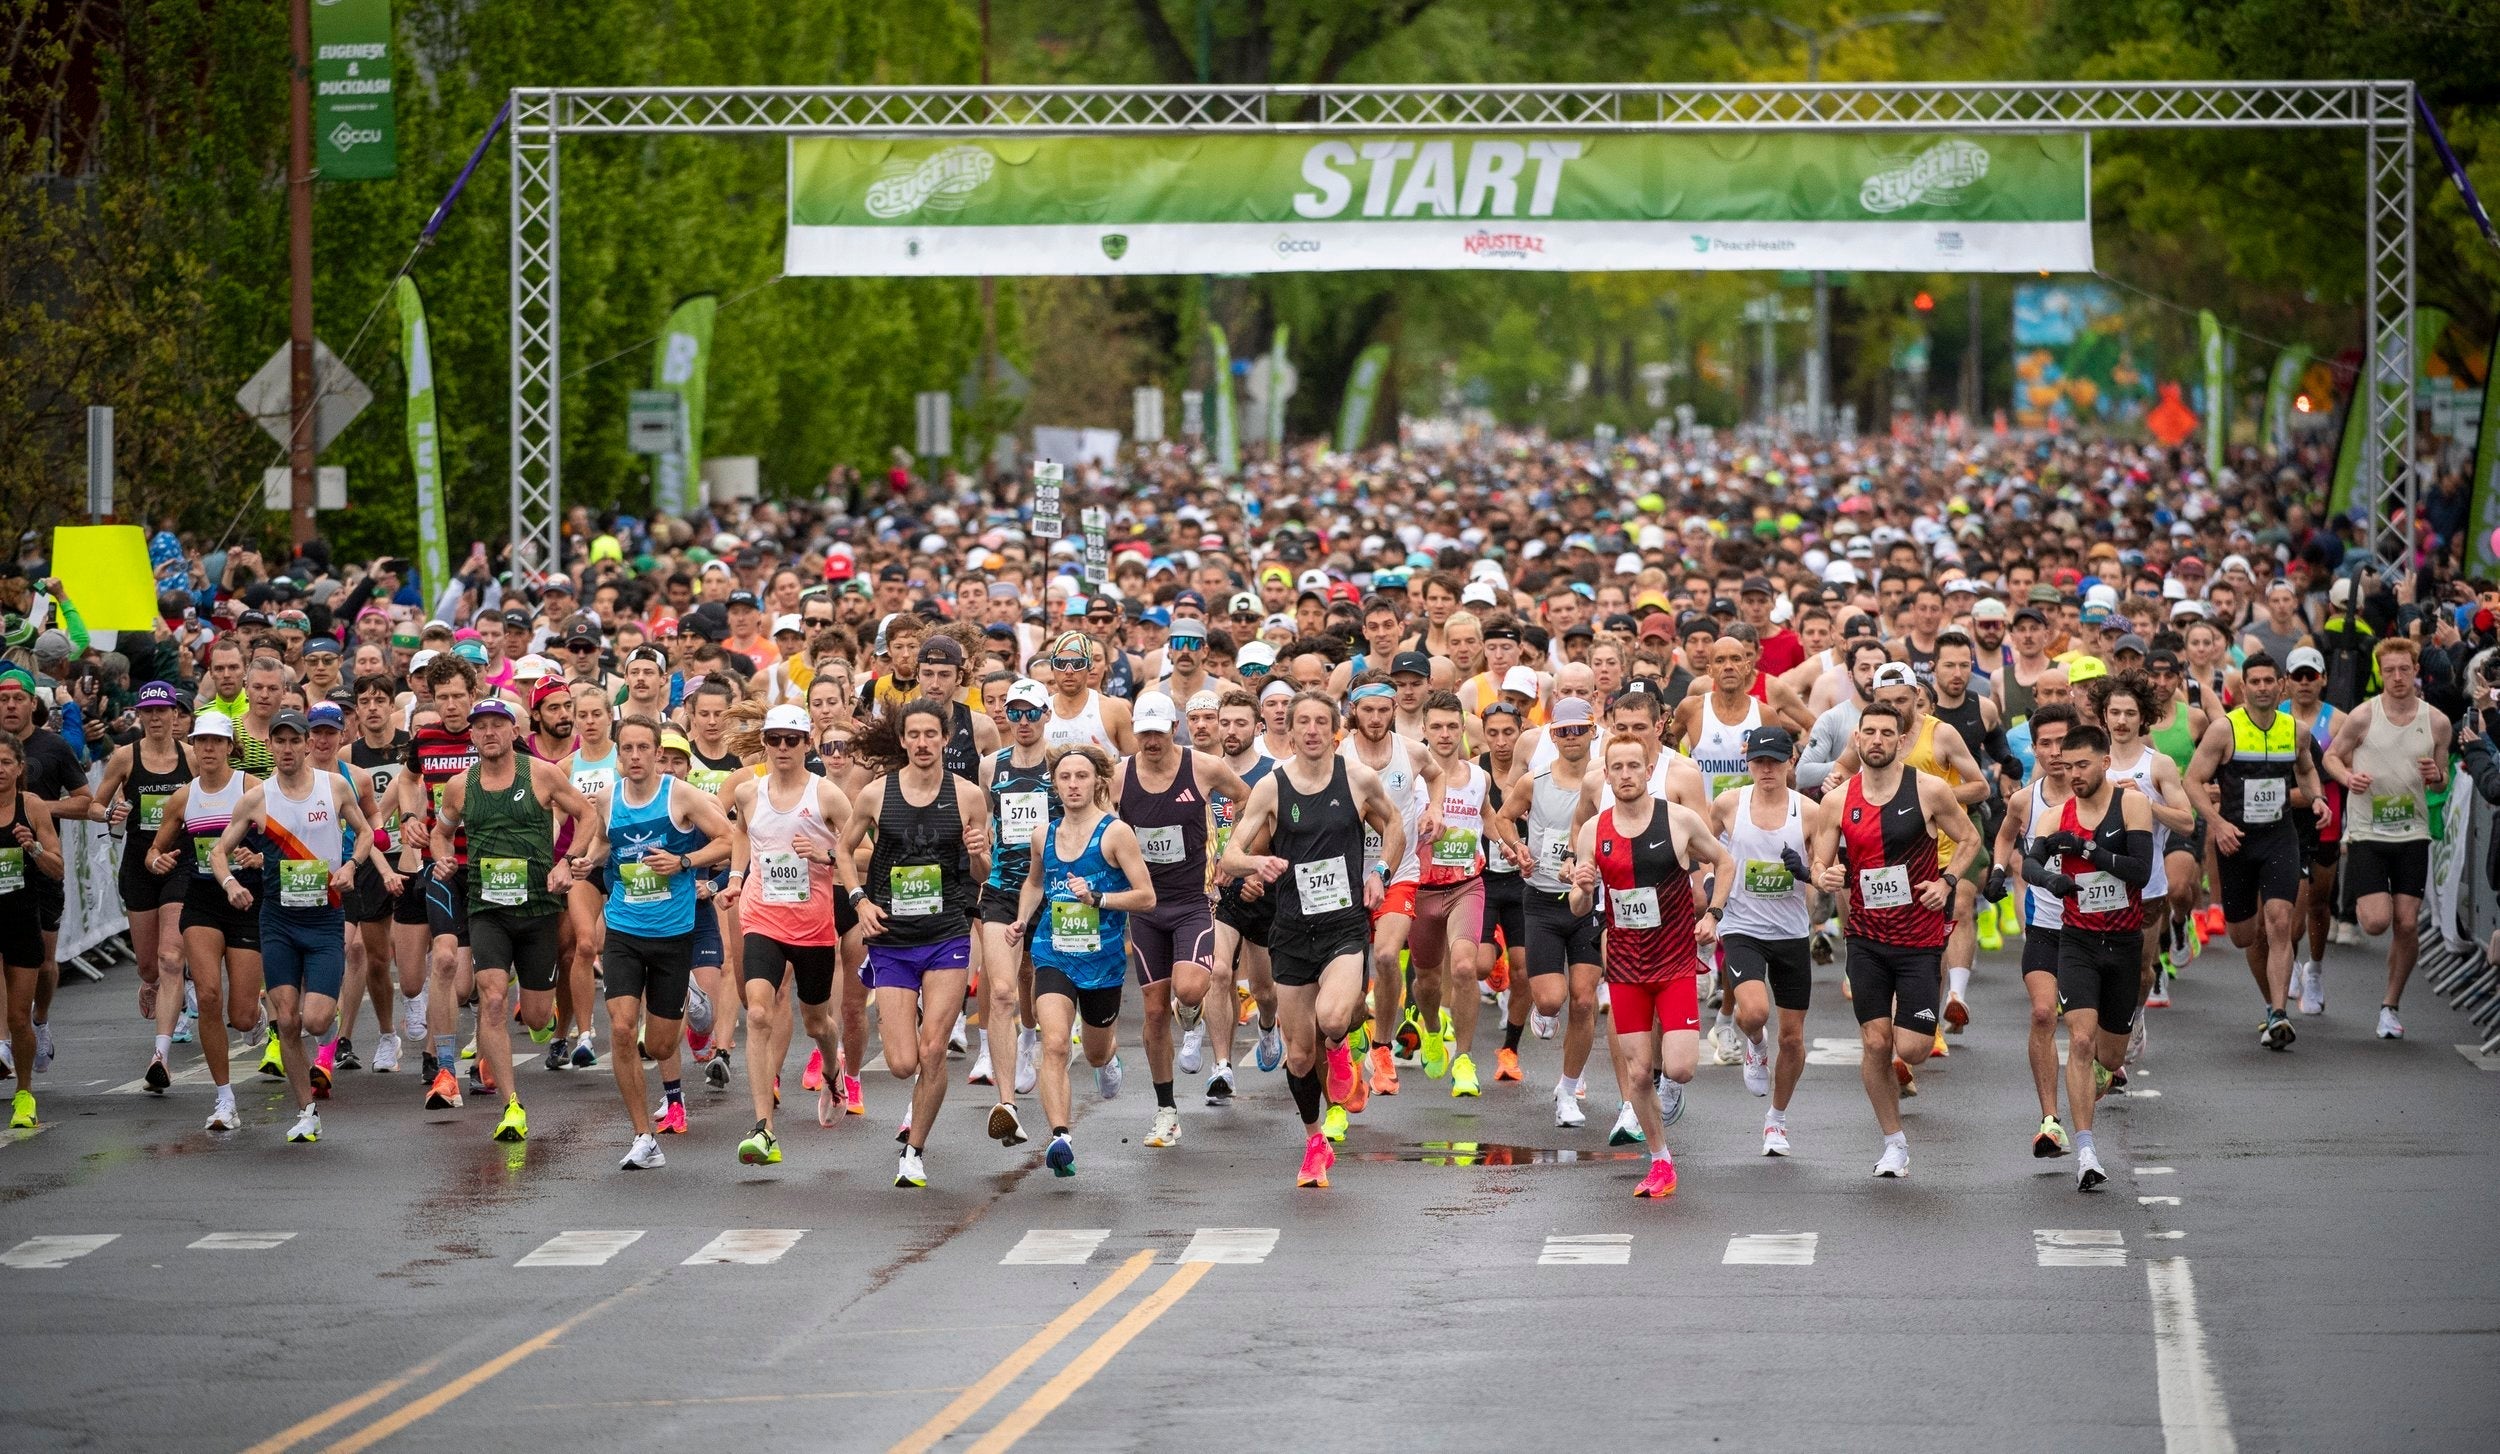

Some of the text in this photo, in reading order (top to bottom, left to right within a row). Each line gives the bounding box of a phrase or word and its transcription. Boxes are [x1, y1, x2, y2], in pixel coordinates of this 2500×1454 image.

[346, 61, 359, 76] &
[338, 129, 382, 144] OCCU
[884, 148, 980, 203] EUGENE
[1294, 141, 1582, 219] START
[1878, 147, 1974, 200] EUGENE
[1278, 240, 1321, 253] OCCU
[1464, 234, 1544, 254] KRUSTEAZ
[1713, 238, 1796, 251] PeaceHealth
[141, 687, 168, 700] ciele
[1052, 730, 1068, 739] run
[424, 755, 481, 770] HARRIER
[948, 762, 966, 770] CLUB
[1697, 759, 1749, 773] DOMINIC
[139, 784, 168, 793] SKYLINE
[375, 775, 389, 790] R
[2254, 791, 2276, 802] 6331
[150, 807, 164, 819] 28
[1011, 807, 1037, 819] 5716
[1445, 805, 1478, 816] LIZARD
[2382, 806, 2406, 818] 2924
[1147, 839, 1172, 851] 6317
[1365, 836, 1383, 847] 821
[1443, 841, 1469, 854] 3029
[1552, 843, 1568, 855] 57
[490, 872, 517, 884] 2489
[770, 866, 798, 879] 6080
[291, 874, 318, 886] 2497
[631, 877, 657, 890] 2411
[901, 880, 931, 893] 2495
[1309, 873, 1336, 889] 5747
[1756, 874, 1785, 887] 2477
[1871, 880, 1898, 895] 5945
[2088, 885, 2116, 899] 5719
[1621, 902, 1647, 916] 5740
[1061, 916, 1089, 930] 2494
